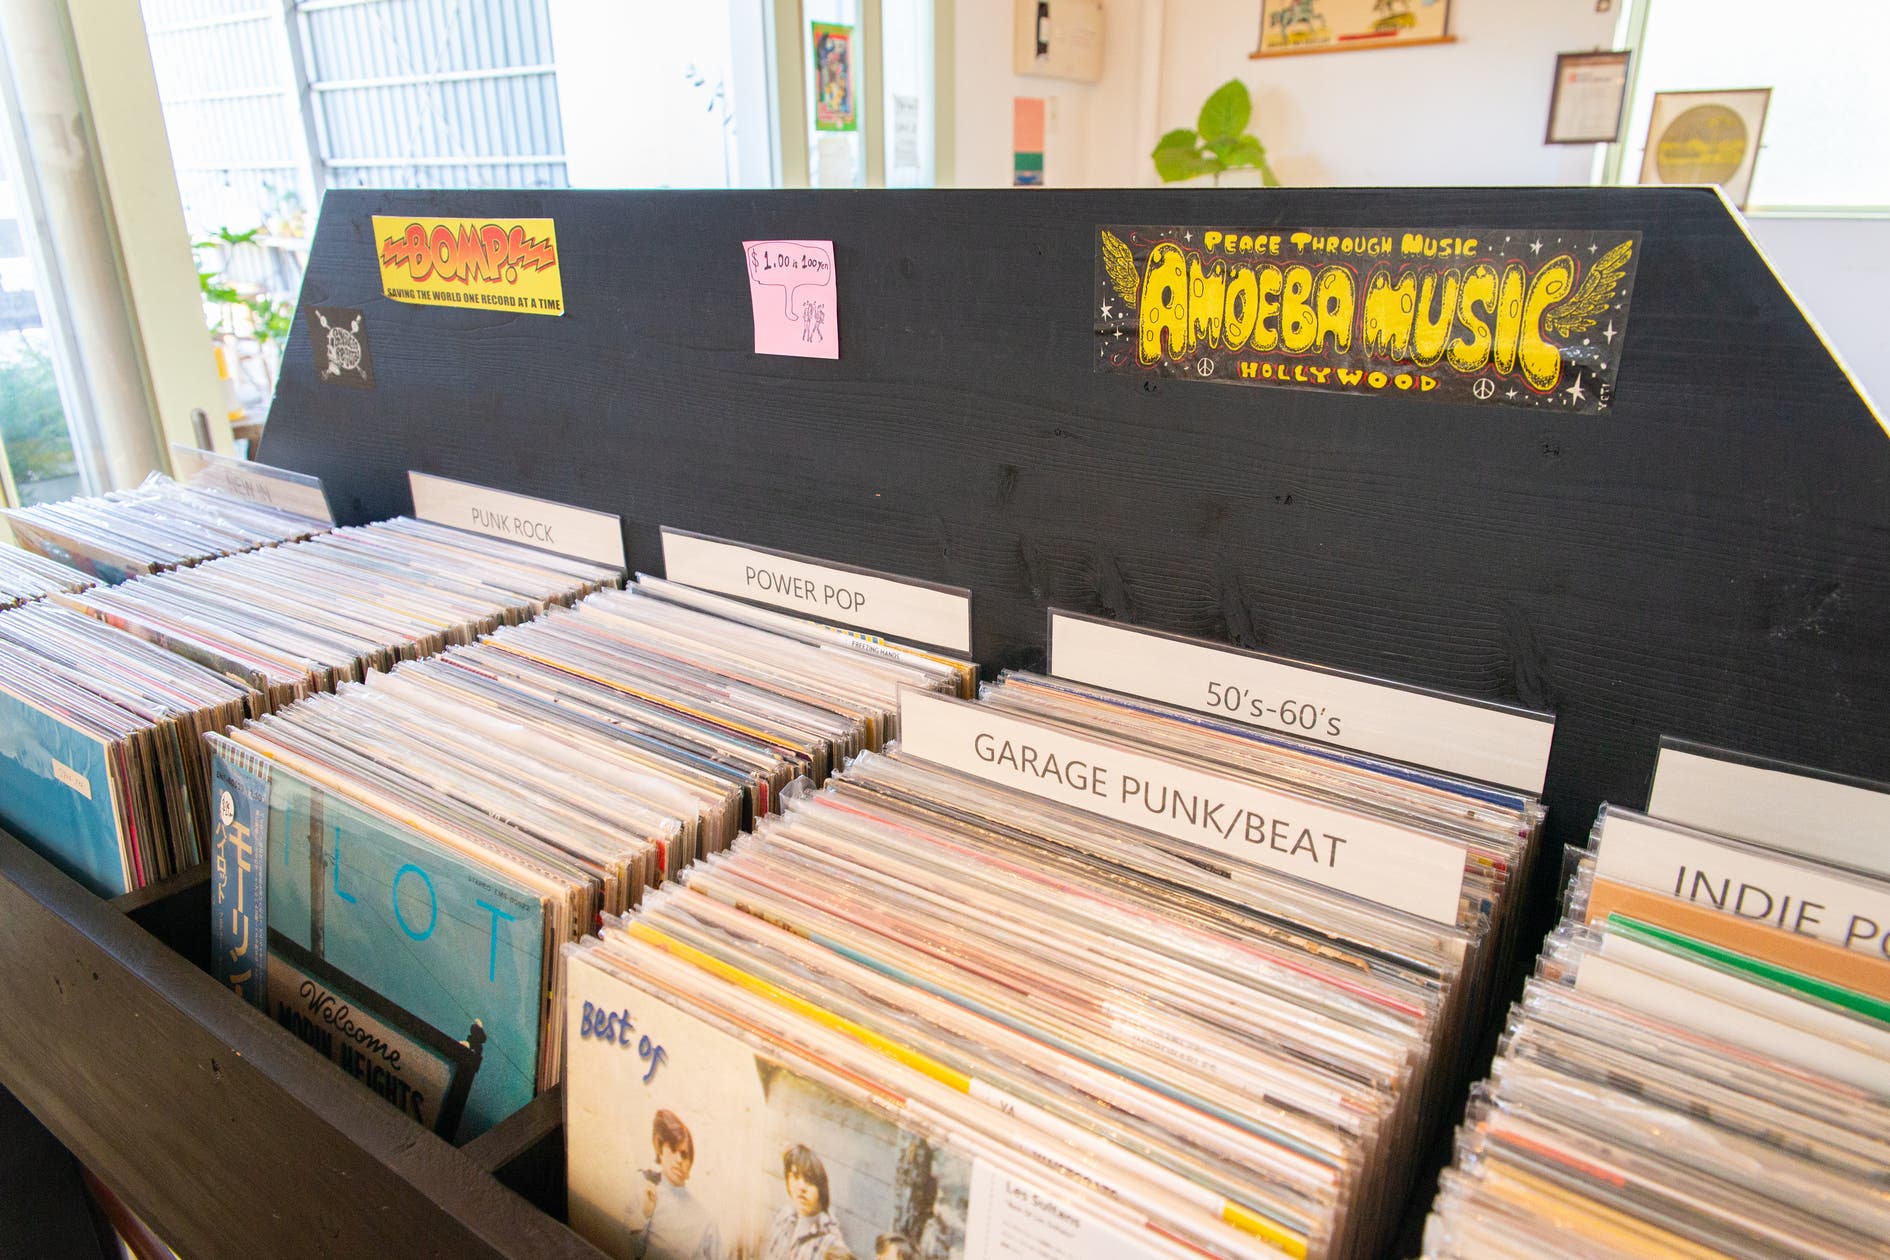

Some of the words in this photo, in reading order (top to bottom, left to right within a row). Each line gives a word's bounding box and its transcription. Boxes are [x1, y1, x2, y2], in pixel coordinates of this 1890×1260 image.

[403, 222, 526, 285] BOMP!
[1204, 231, 1281, 254] PEACE
[1290, 232, 1392, 256] THROUGH
[1402, 233, 1478, 257] MUSIC
[387, 287, 416, 299] SAVING
[417, 290, 431, 300] THE
[433, 291, 461, 303] WORLD
[464, 293, 479, 304] ONE
[481, 294, 516, 307] RECORD
[518, 297, 529, 307] AT
[531, 298, 537, 308] A
[539, 299, 561, 311] TIME
[1139, 242, 1356, 366] AMOEBA
[1363, 254, 1575, 392] MUSIC
[1240, 361, 1437, 393] HOLLYWOOD
[471, 507, 511, 534] PUNK
[513, 518, 554, 544] ROCK
[746, 566, 817, 602] POWER
[824, 585, 866, 612] POP
[851, 640, 879, 655] FREEZING
[880, 648, 900, 660] HANDS
[974, 733, 1108, 798] GARAGE
[1121, 775, 1347, 868] PUNK/BEAT
[1674, 866, 1825, 939] INDIE
[1843, 914, 1890, 962] P
[300, 980, 401, 1070] Welcome
[580, 1000, 635, 1047] Best
[638, 1034, 668, 1084] of
